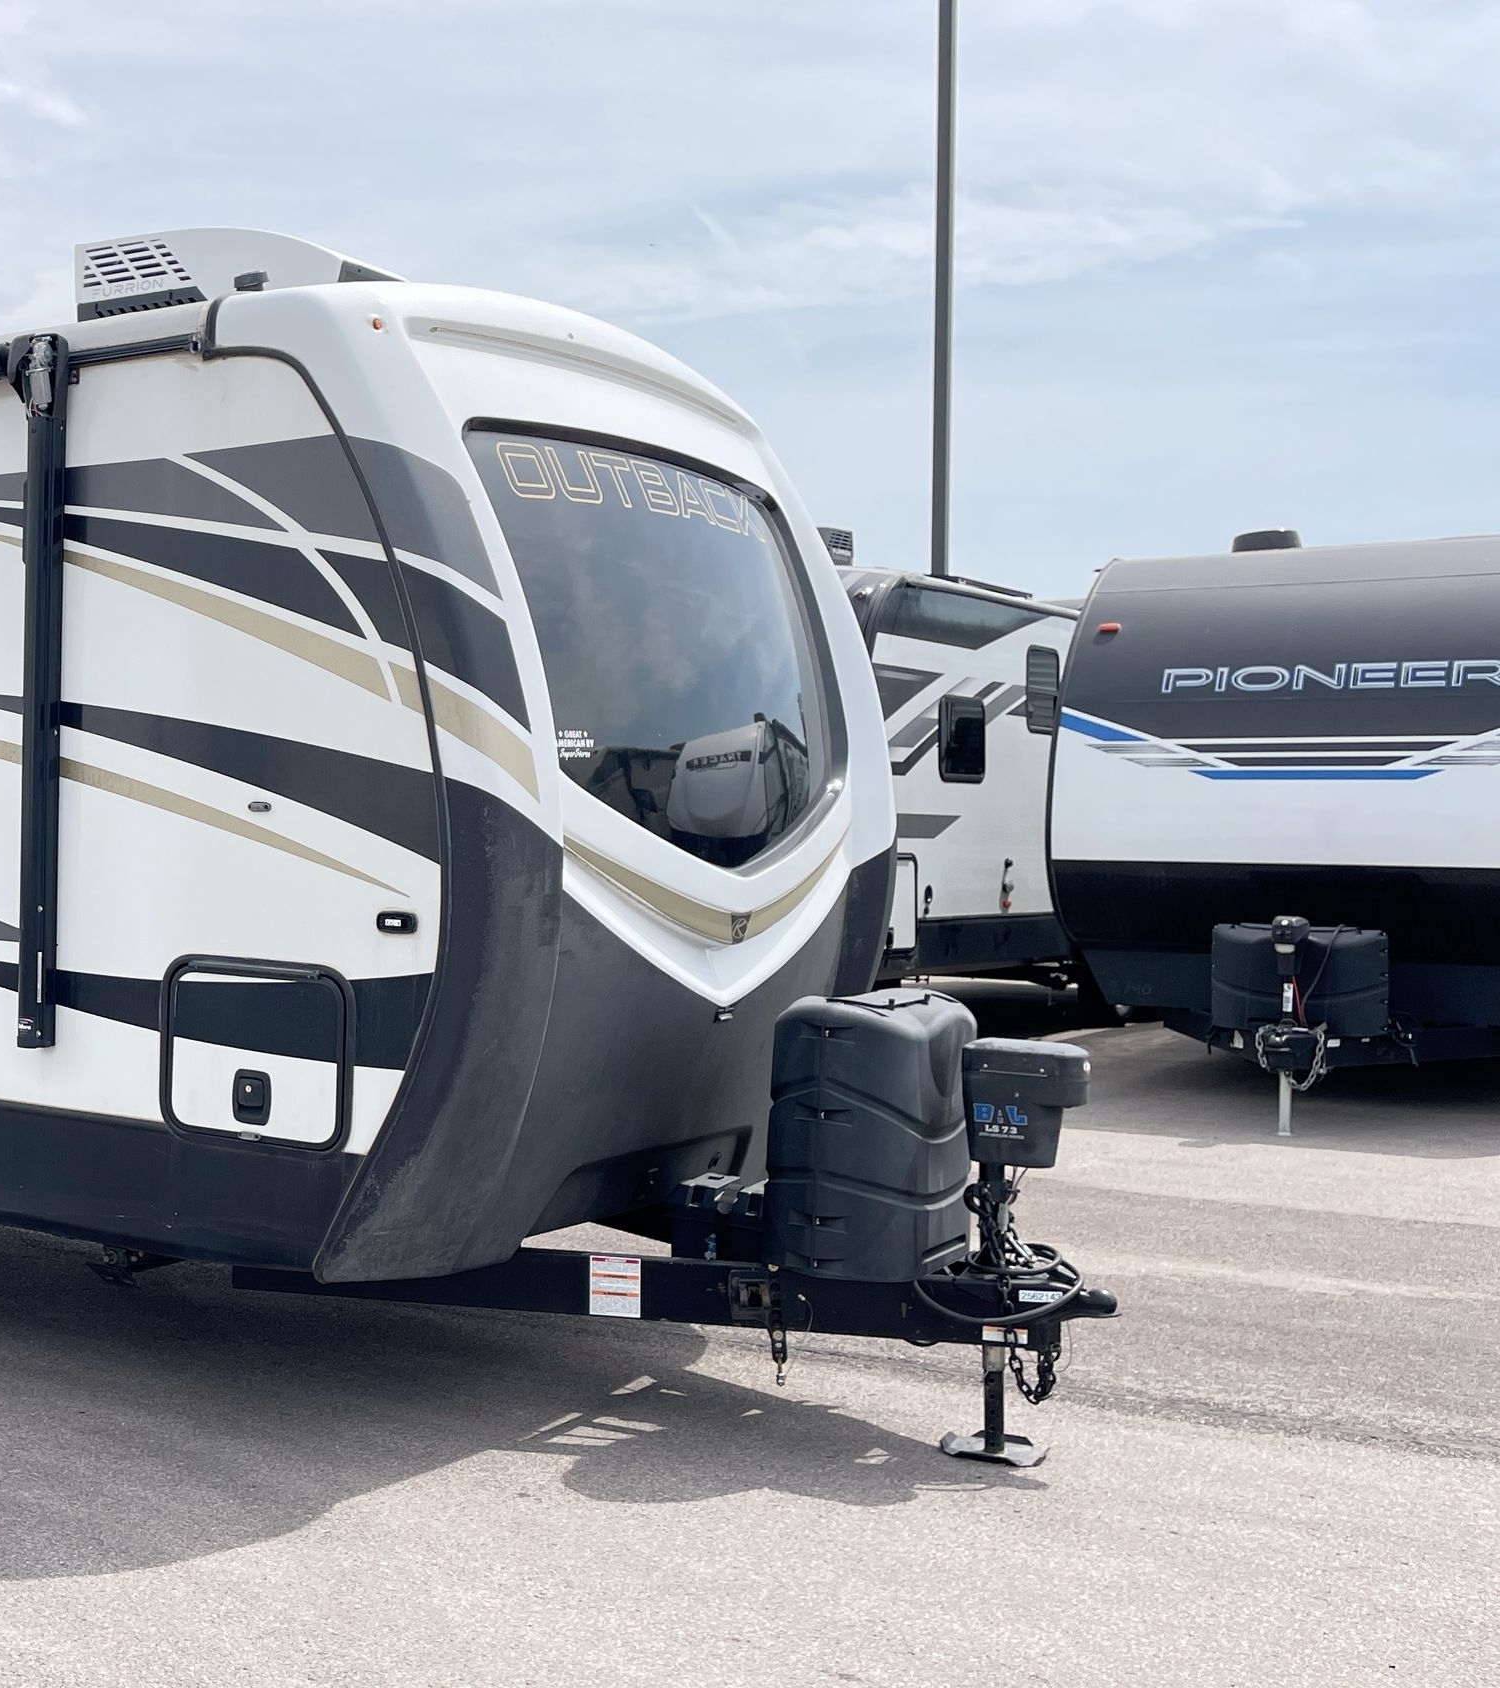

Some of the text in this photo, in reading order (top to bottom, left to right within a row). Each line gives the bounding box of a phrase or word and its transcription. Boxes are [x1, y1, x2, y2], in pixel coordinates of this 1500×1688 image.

[92, 278, 164, 299] FURRION
[496, 441, 767, 544] OUTBACK
[1161, 659, 1500, 693] PIONEER
